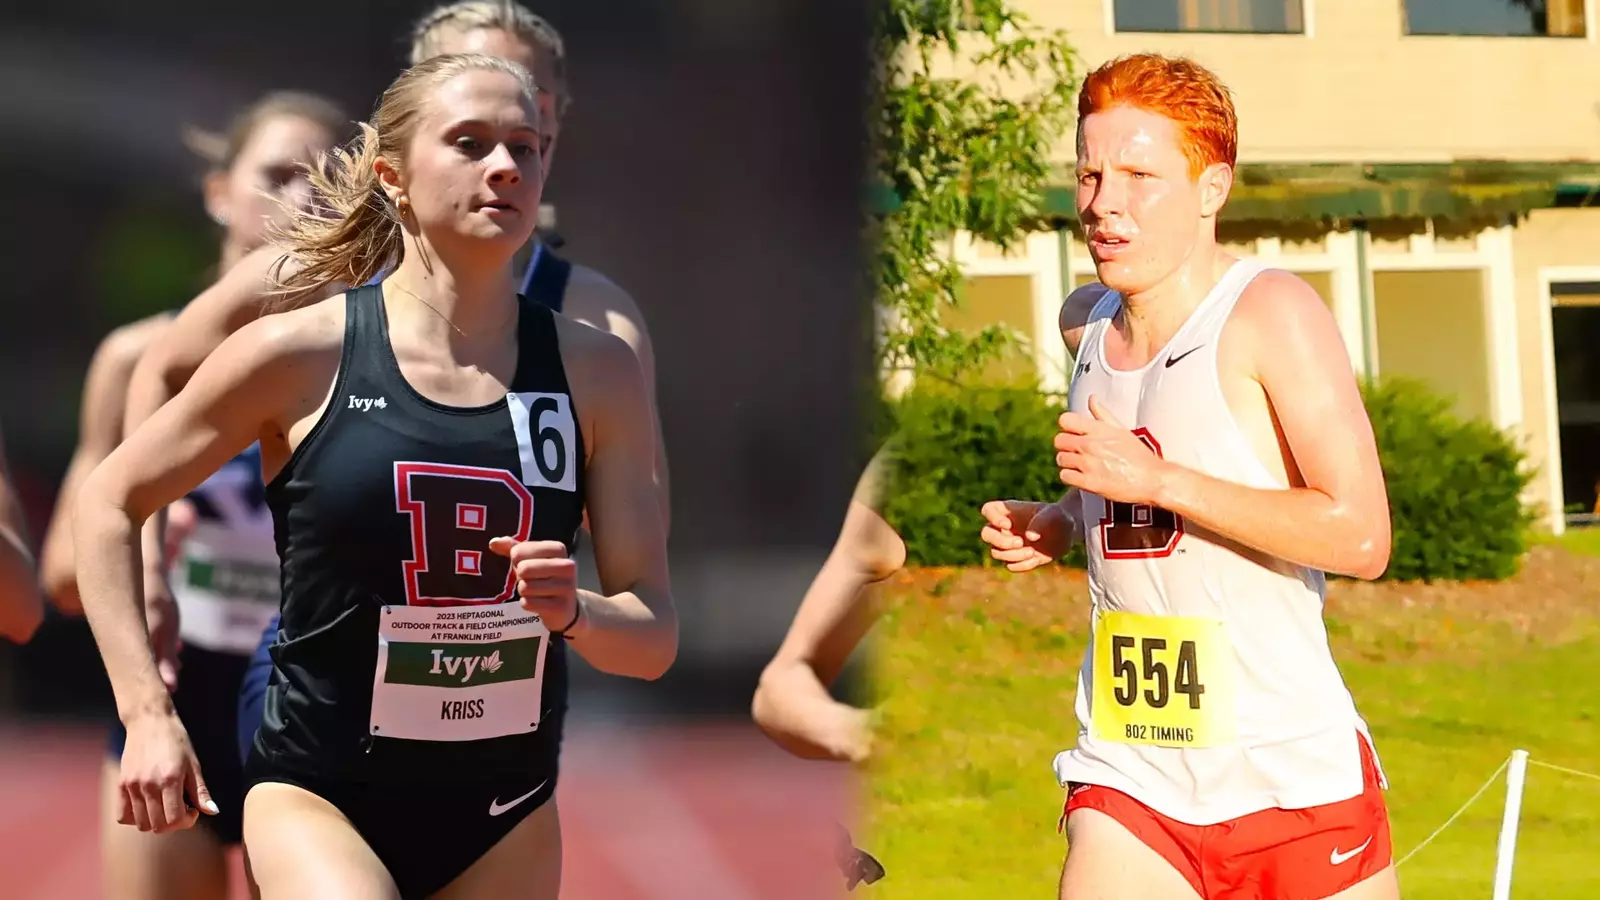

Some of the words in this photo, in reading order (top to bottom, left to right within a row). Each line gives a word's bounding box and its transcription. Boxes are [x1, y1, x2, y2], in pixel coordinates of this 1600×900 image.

[347, 395, 374, 412] Ivy
[529, 397, 566, 484] 6
[393, 461, 534, 607] B
[391, 621, 431, 630] OUTDOOR
[466, 622, 487, 630] FIELD
[487, 615, 540, 629] CHAMPIONSHIPS
[456, 610, 504, 620] HEPTAGONAL
[443, 633, 482, 641] FRANKLIN
[483, 632, 502, 640] FIELD
[429, 649, 481, 683] Ivy
[1112, 635, 1205, 709] 554
[440, 698, 485, 720] KRISS
[1125, 723, 1147, 740] 802
[1150, 725, 1194, 742] TIMING
